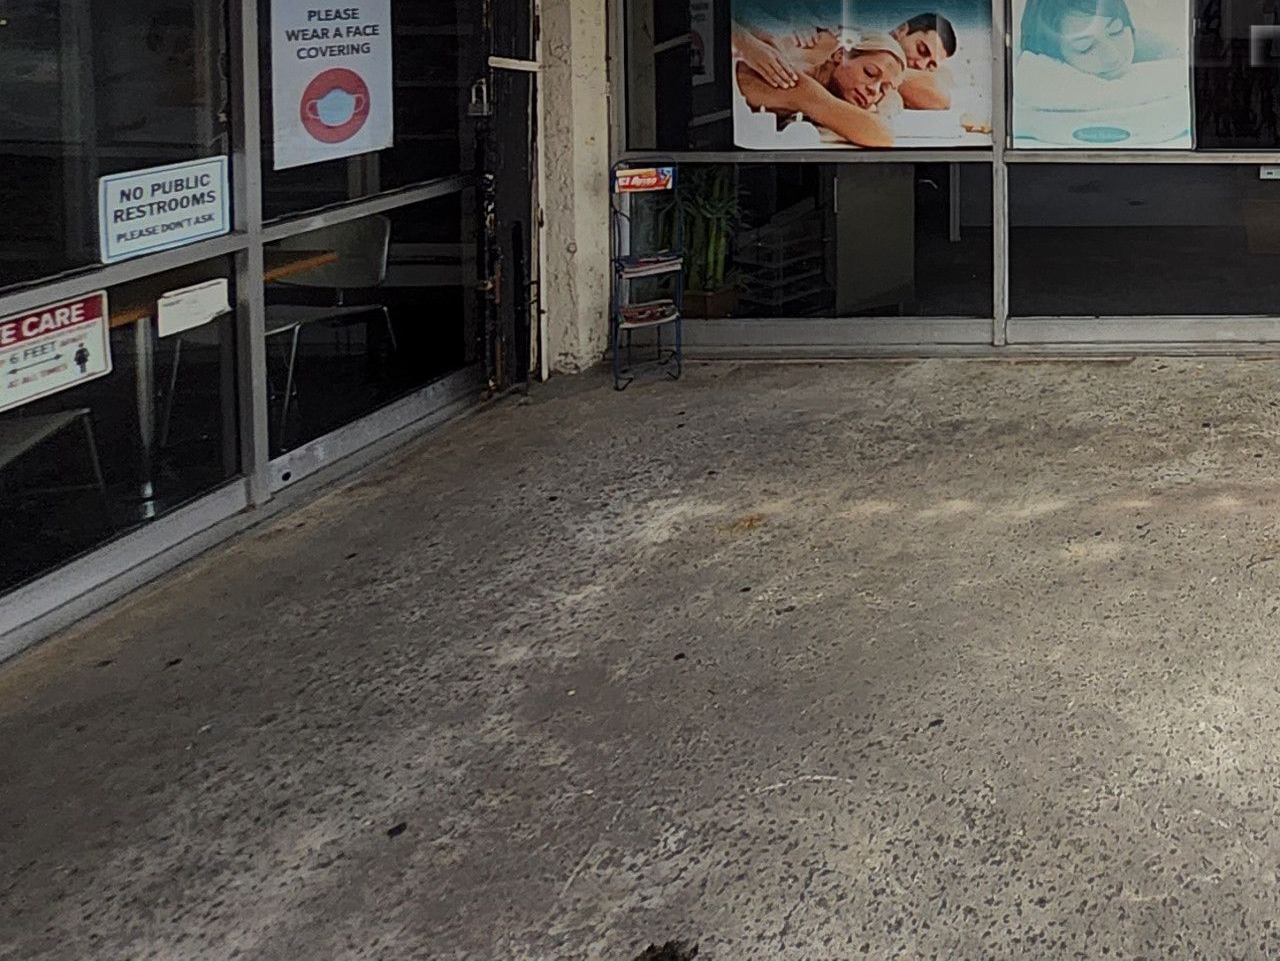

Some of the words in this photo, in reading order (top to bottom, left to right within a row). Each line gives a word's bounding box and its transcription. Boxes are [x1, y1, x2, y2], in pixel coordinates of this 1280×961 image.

[307, 8, 360, 22] PLEASE
[285, 28, 329, 41] WEAR
[333, 27, 343, 38] A
[346, 24, 379, 37] FACE
[296, 42, 371, 59] COVERING
[120, 186, 144, 203] NO
[150, 173, 211, 197] PUBLIC
[113, 190, 216, 224] RESTROOMS
[116, 224, 160, 243] PLEASE
[161, 217, 193, 234] DON'T
[193, 212, 216, 226] ASK
[21, 303, 86, 337] CARE
[9, 353, 18, 365] 6
[23, 341, 57, 360] FEET
